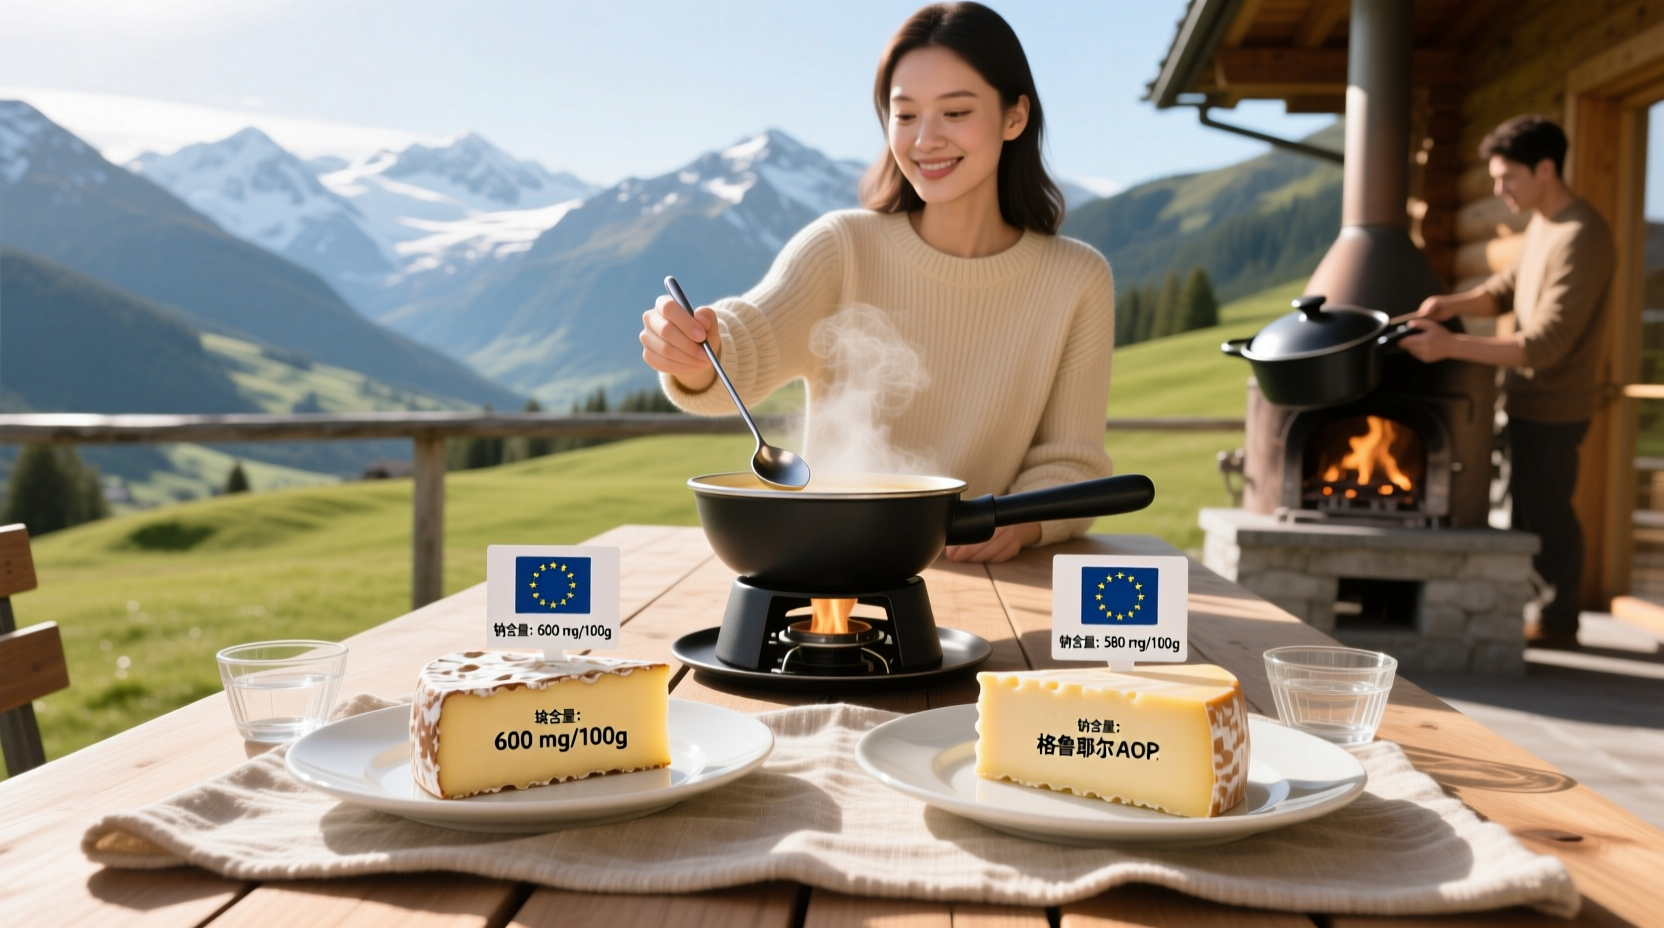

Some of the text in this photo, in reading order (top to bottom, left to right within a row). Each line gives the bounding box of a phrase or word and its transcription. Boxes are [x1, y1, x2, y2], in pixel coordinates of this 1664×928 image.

[537, 623, 560, 637] 600
[1104, 635, 1126, 648] 580
[494, 726, 628, 752] 600 mg/100g
